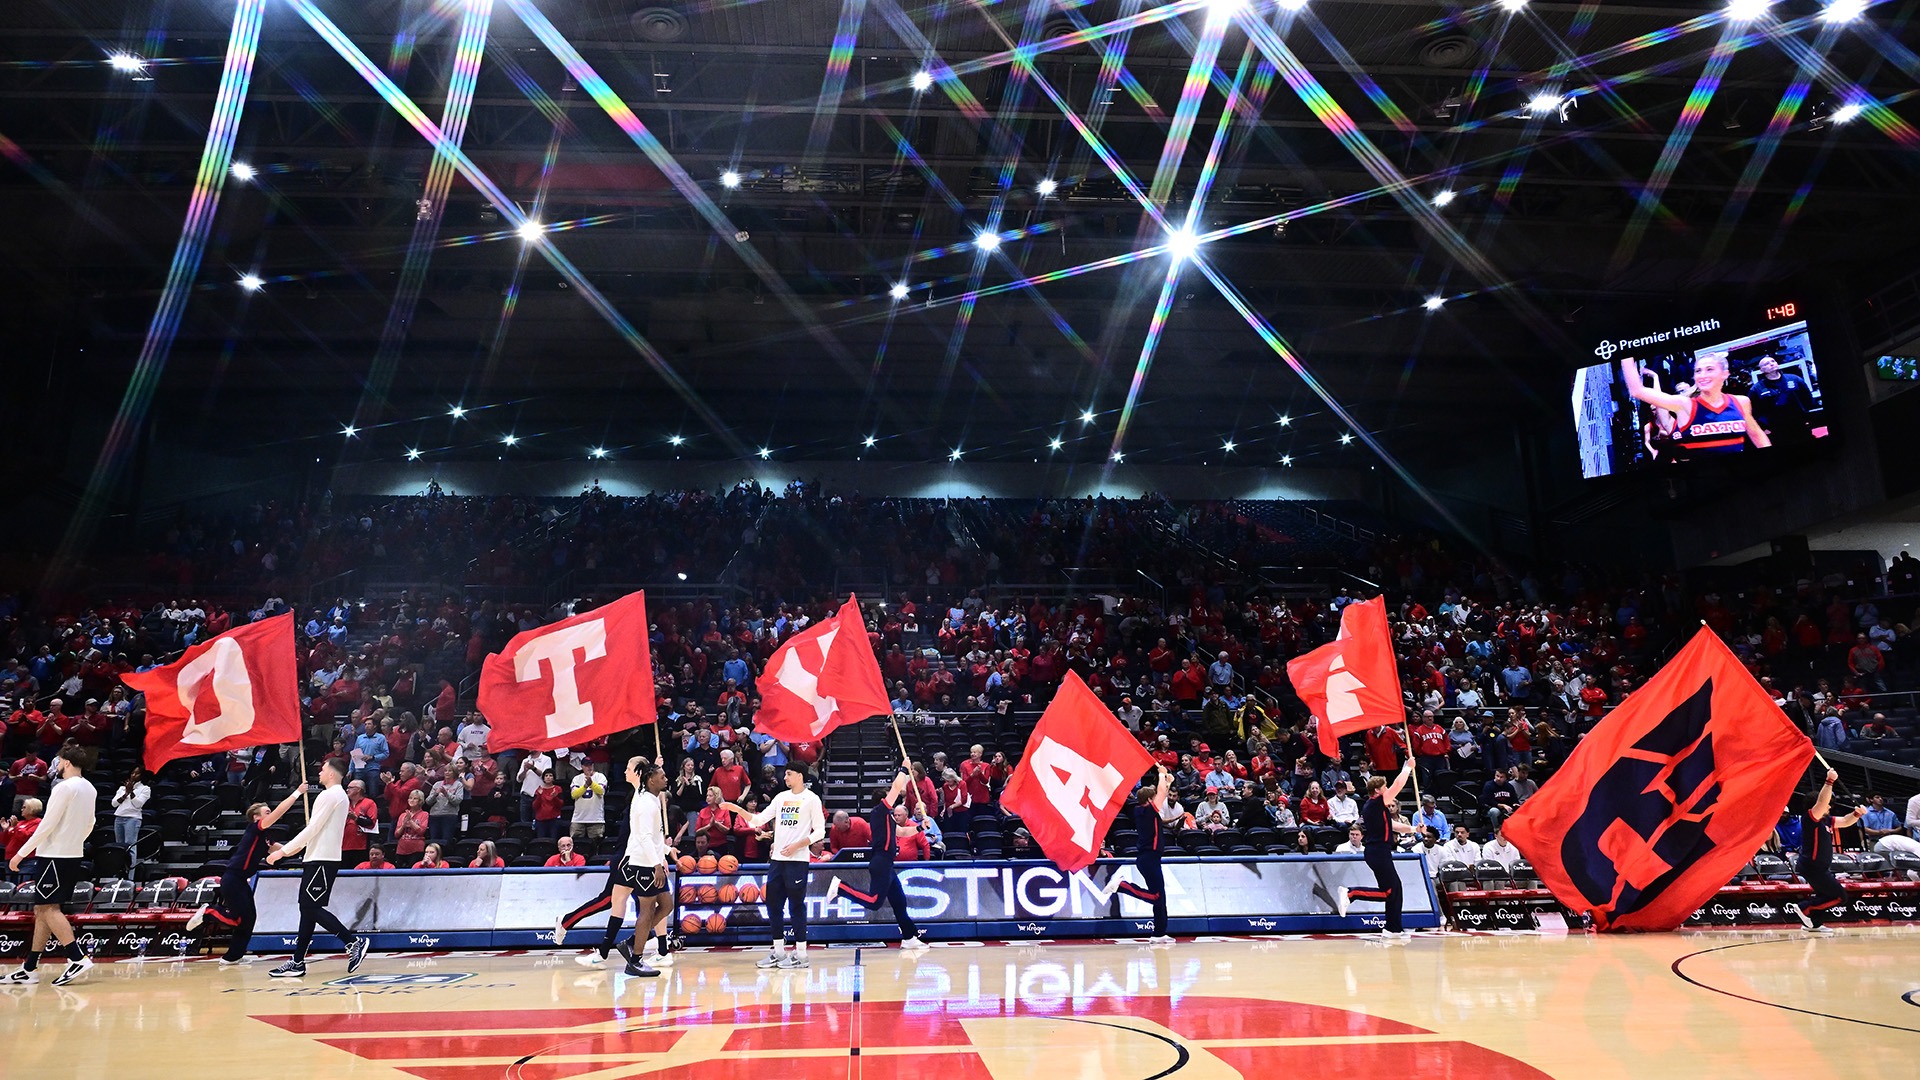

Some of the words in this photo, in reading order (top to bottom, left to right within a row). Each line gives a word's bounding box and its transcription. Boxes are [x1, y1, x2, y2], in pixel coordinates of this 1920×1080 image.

[1767, 303, 1795, 320] 1:48
[1619, 331, 1671, 351] Premier
[1673, 318, 1721, 338] Health
[513, 617, 607, 739] T
[1030, 735, 1124, 853] A
[216, 839, 228, 847] 103
[1495, 908, 1525, 924] Kroger
[1711, 904, 1741, 920] Kroger
[1747, 903, 1777, 919] Kroger
[1853, 900, 1883, 916] Kroger
[1887, 902, 1918, 917] Kroger
[1257, 918, 1277, 930] Kroger
[1370, 916, 1387, 928] Kroge
[1457, 909, 1488, 925] Kroger
[1026, 922, 1047, 935] Kroger
[418, 934, 440, 947] Kroger
